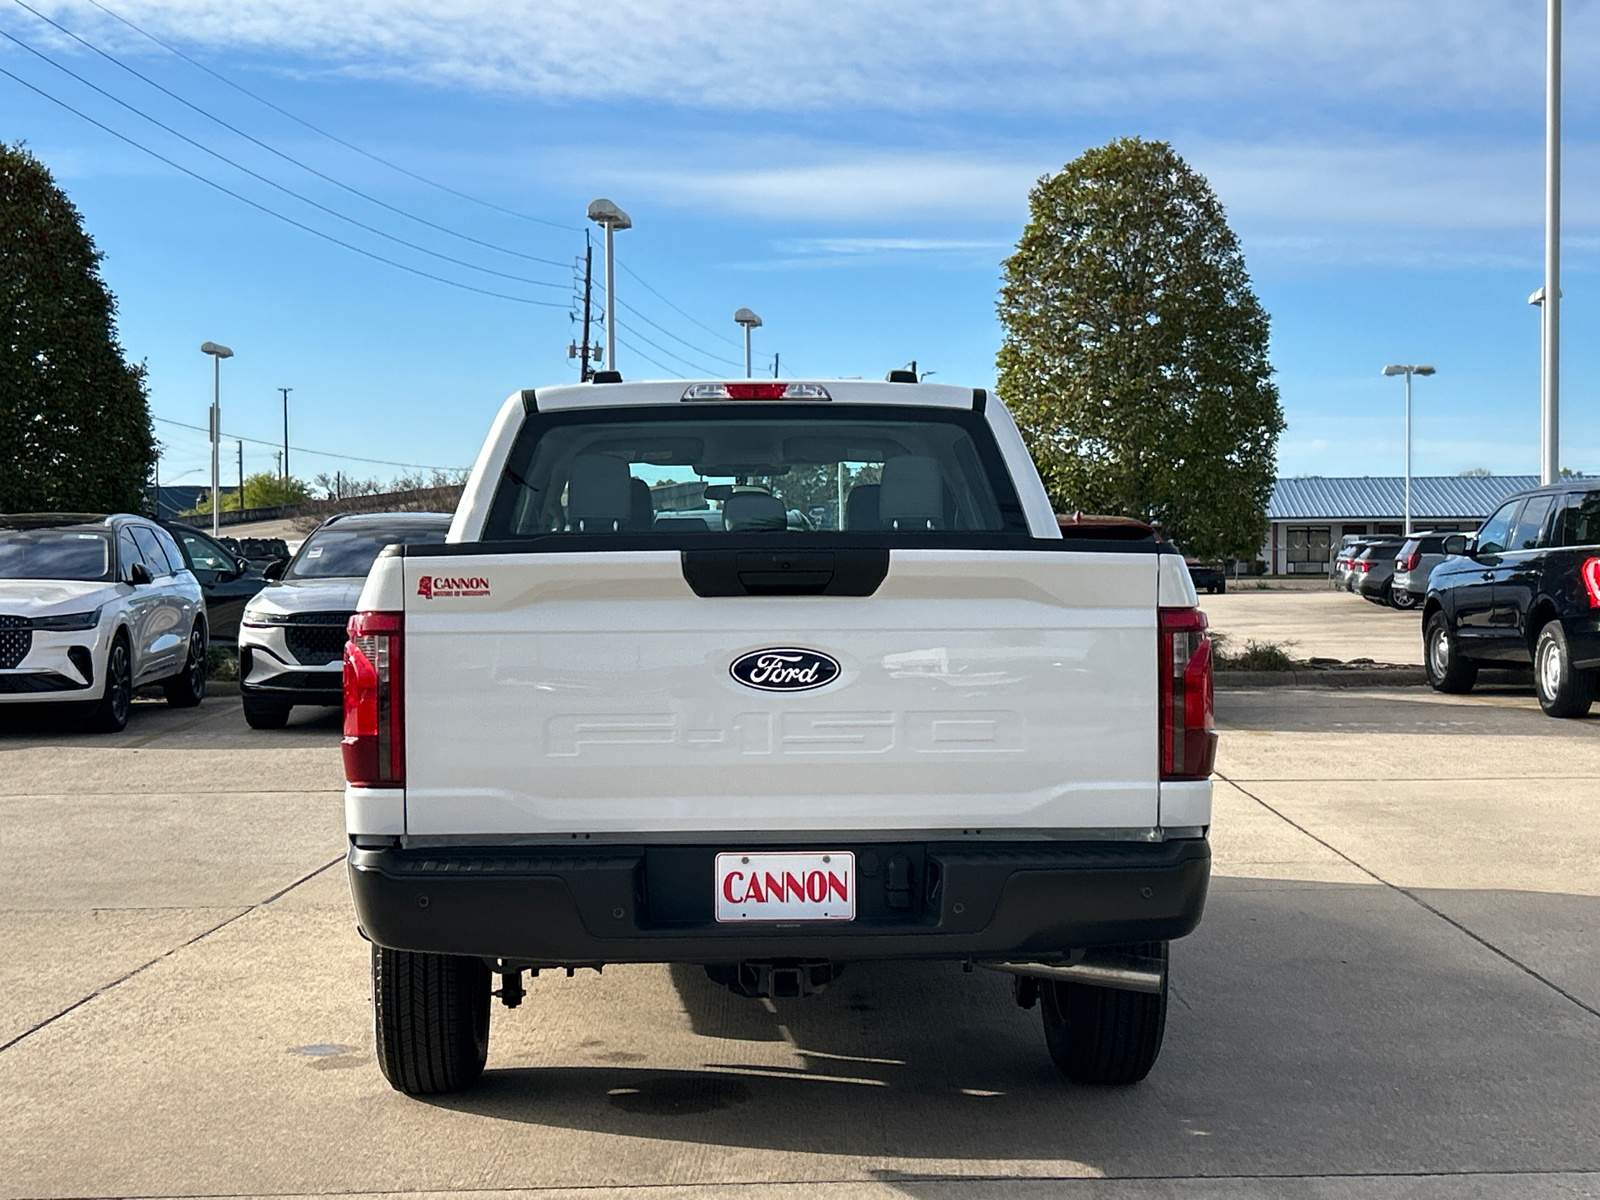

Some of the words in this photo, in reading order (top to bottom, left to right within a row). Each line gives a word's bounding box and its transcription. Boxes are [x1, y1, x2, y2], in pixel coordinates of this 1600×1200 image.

[433, 577, 489, 589] CANNON
[750, 654, 821, 683] Ford
[544, 709, 1027, 757] F-150
[723, 870, 848, 904] CANNON
